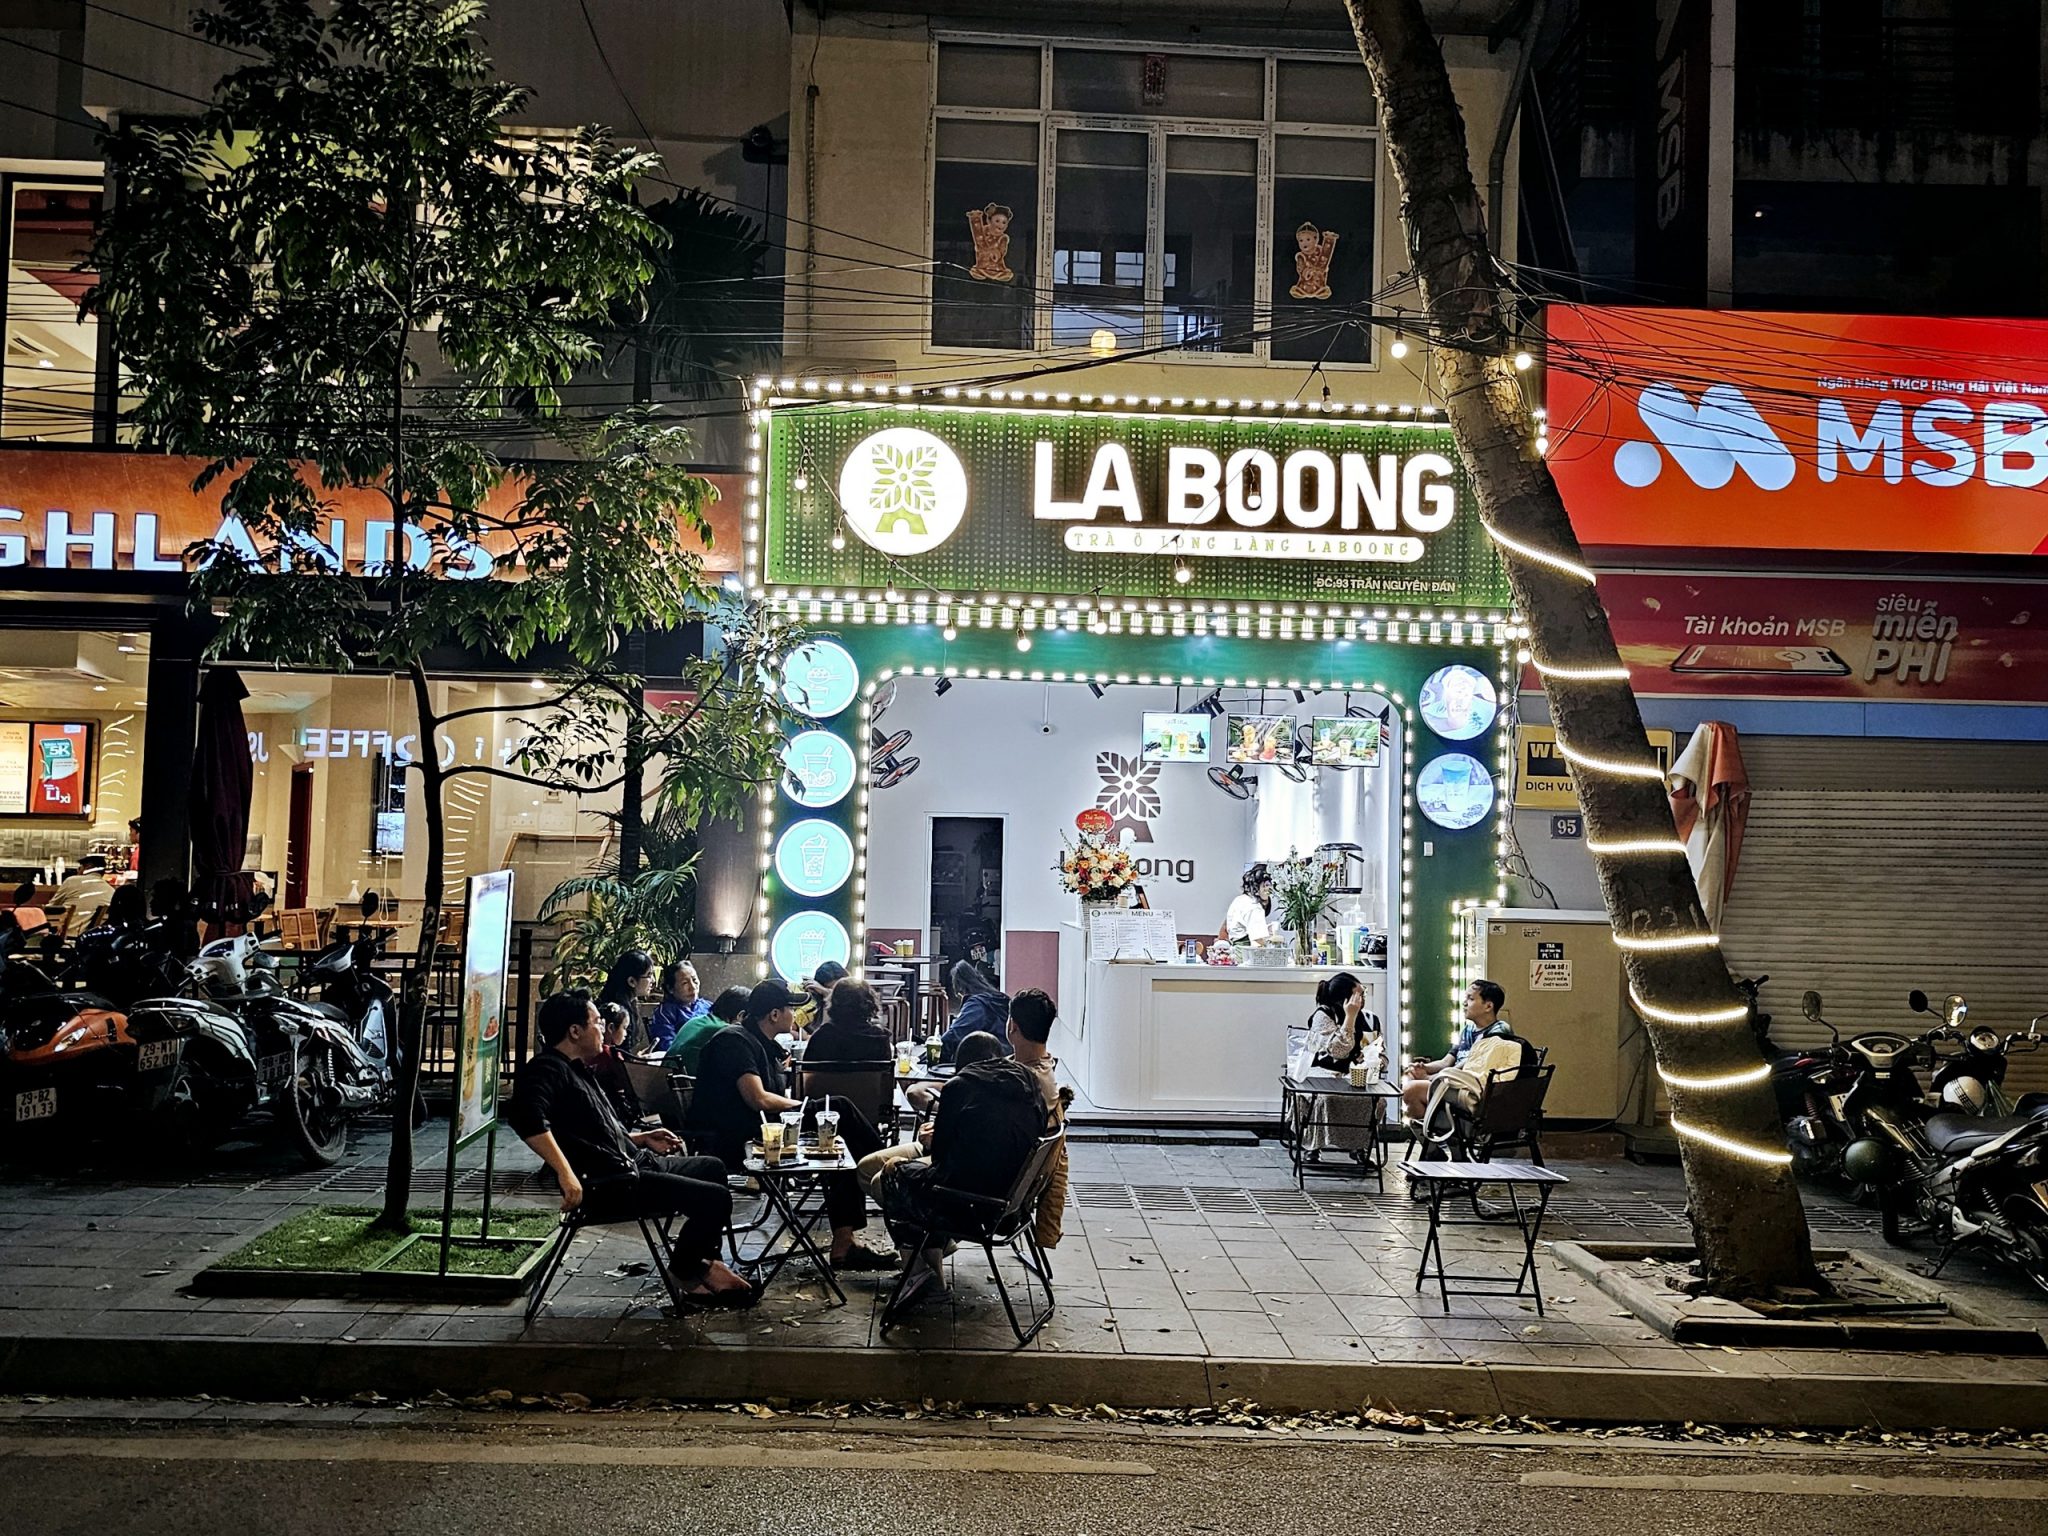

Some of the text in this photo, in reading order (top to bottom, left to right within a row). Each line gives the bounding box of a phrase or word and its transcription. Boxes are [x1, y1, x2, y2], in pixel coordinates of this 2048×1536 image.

[1892, 379, 1929, 391] TMCP
[1817, 398, 2048, 488] MSB
[1034, 441, 1455, 533] LA BOONG
[1074, 531, 1116, 547] TRÀ
[1161, 534, 1217, 550] LONG
[1233, 535, 1291, 552] LÀNG
[1307, 540, 1409, 556] LABOONG
[1876, 594, 1921, 612] siêu
[1683, 614, 1847, 638] Tài khoản MSB
[1871, 600, 1960, 642] miễn
[49, 744, 71, 757] 5K
[1525, 781, 1554, 793] DỊCH
[1557, 819, 1577, 835] 95
[1060, 850, 1195, 884] Long
